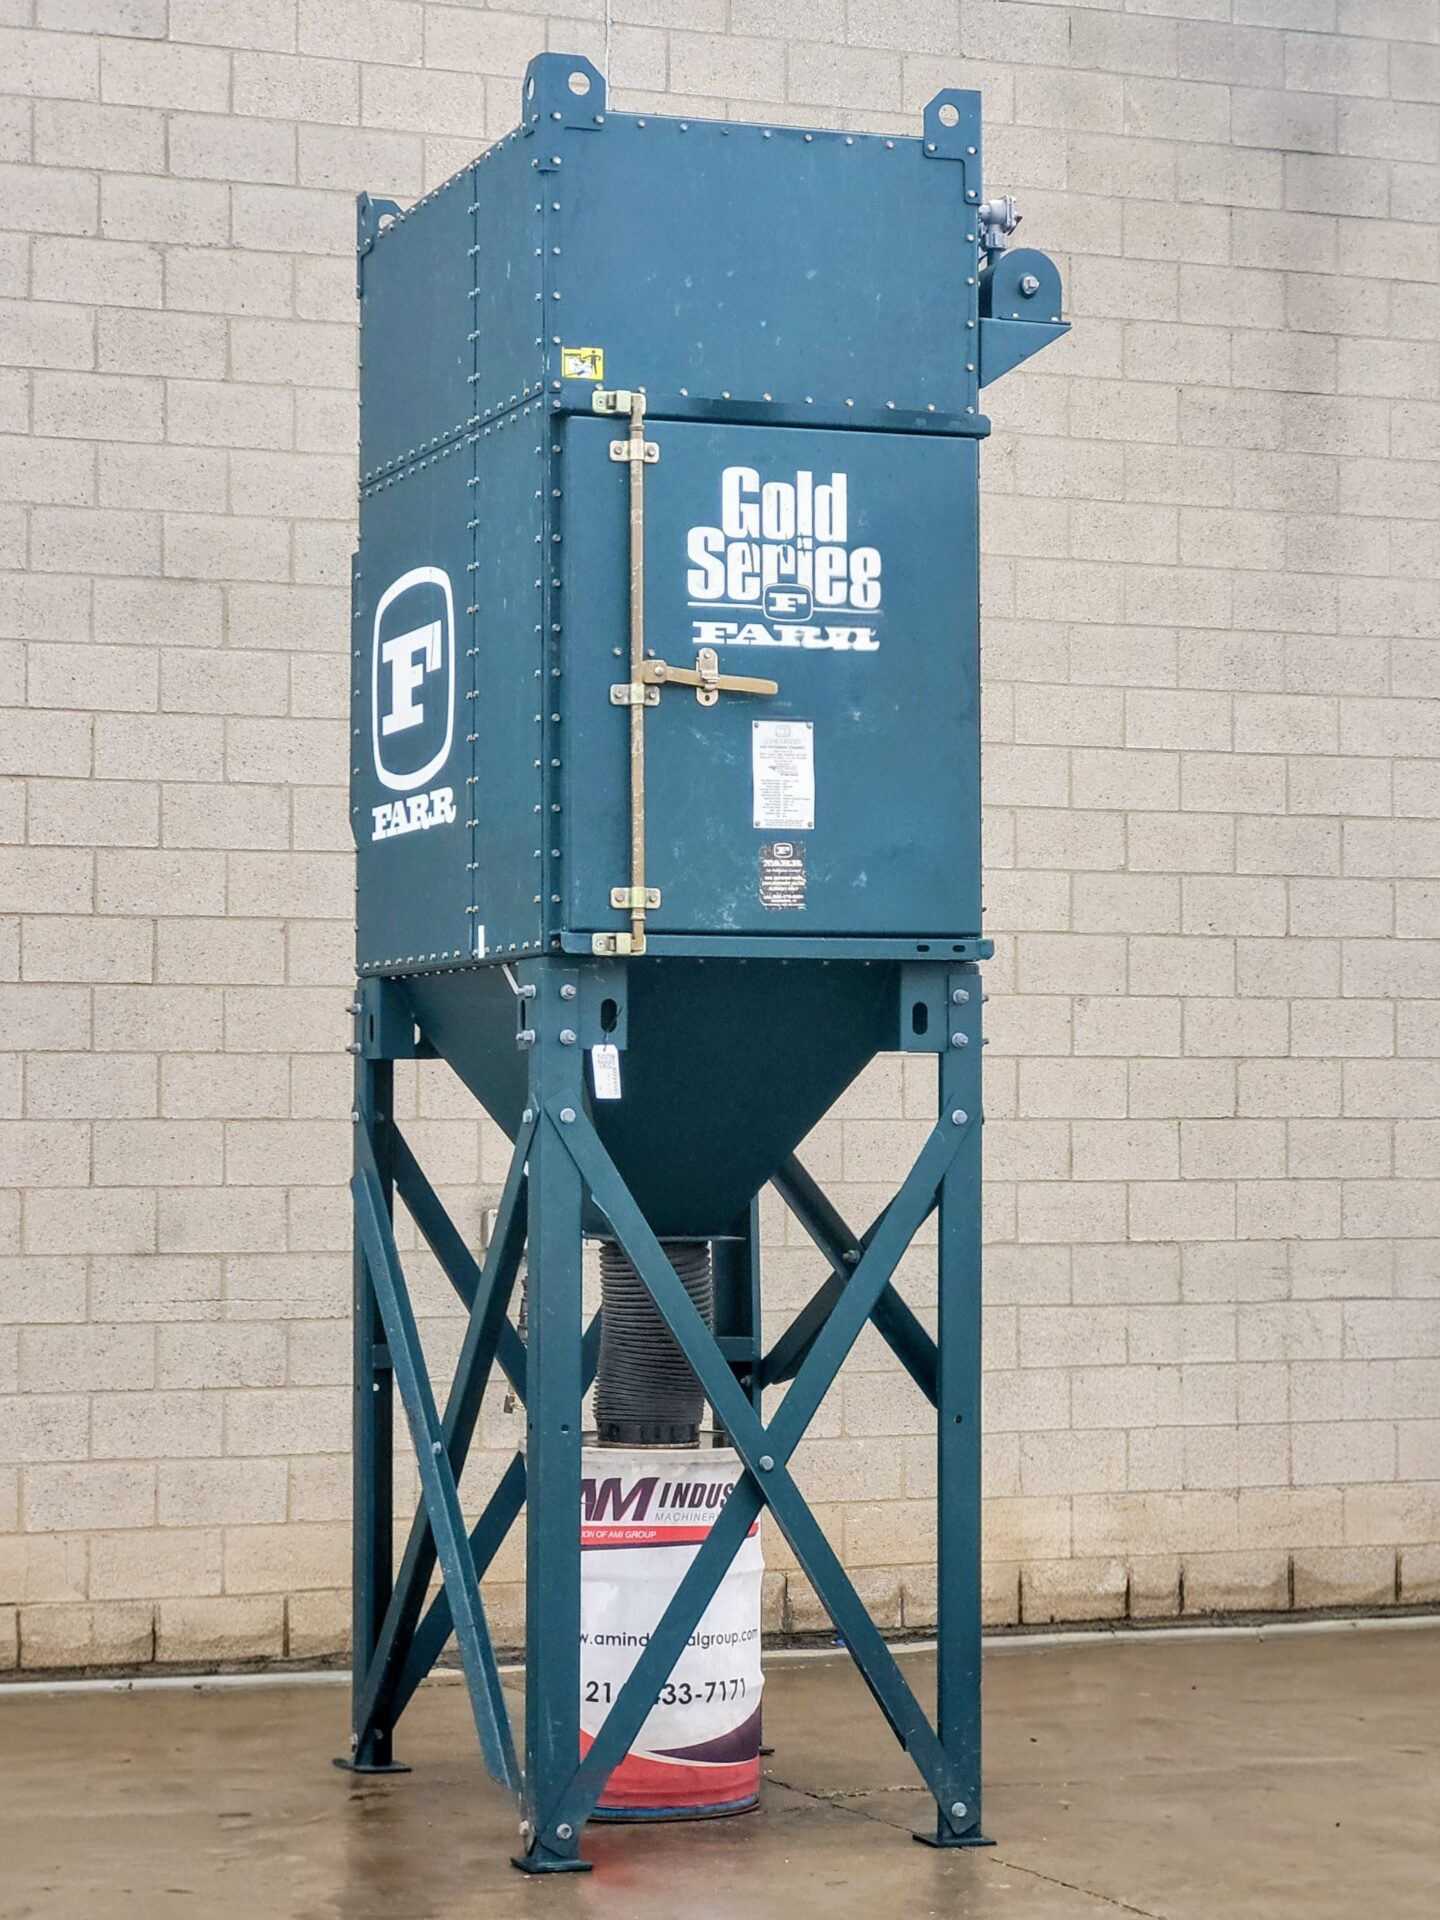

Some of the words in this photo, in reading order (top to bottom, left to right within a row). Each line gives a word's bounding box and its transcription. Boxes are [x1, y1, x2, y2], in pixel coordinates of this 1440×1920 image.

[722, 466, 848, 542] Gold
[687, 526, 882, 609] Series
[768, 592, 807, 612] F
[692, 621, 880, 651] FARR
[382, 619, 442, 736] F
[372, 786, 457, 841] FARR
[595, 1530, 608, 1538] OF
[607, 1530, 624, 1539] AMI
[624, 1530, 657, 1539] GROUP
[655, 1512, 720, 1521] MACHINER
